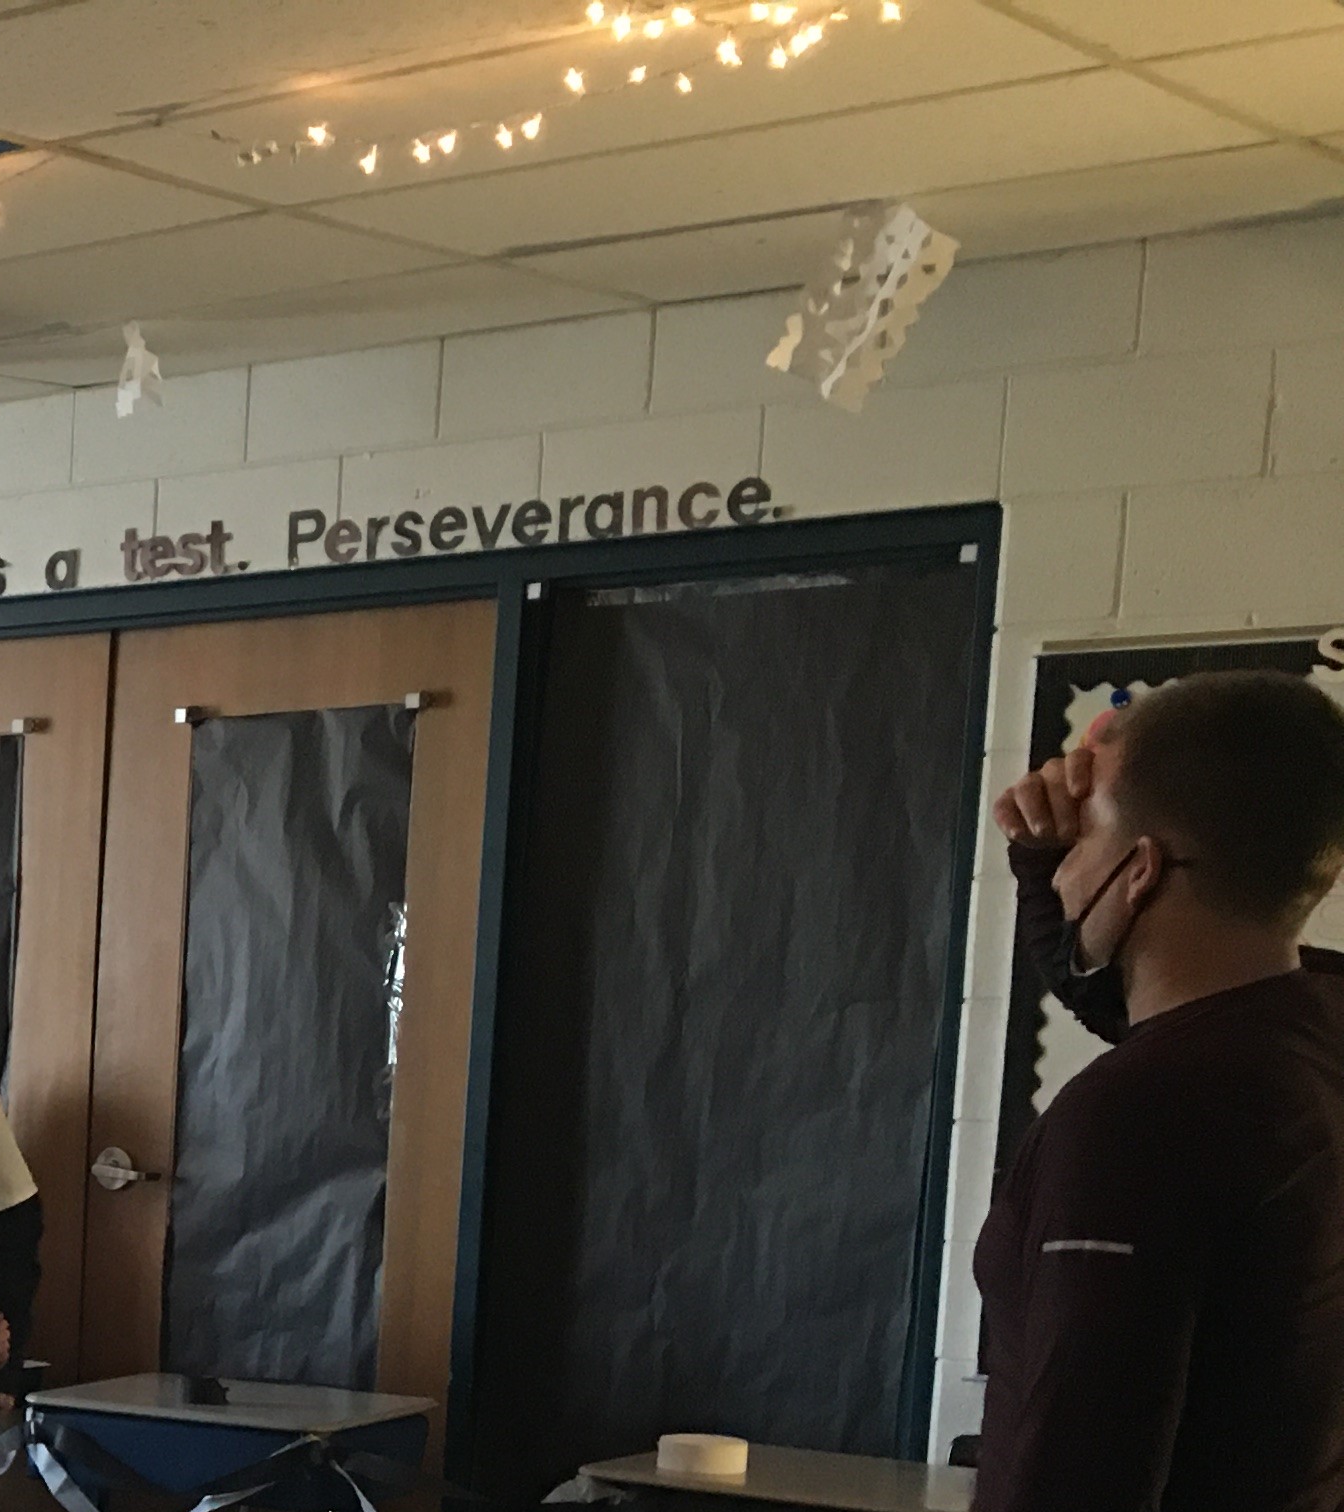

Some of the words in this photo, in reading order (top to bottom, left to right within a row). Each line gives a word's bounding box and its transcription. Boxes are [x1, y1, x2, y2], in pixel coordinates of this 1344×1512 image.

[44, 548, 81, 590] a
[120, 520, 250, 583] test.
[287, 476, 796, 567] Perseverance.
